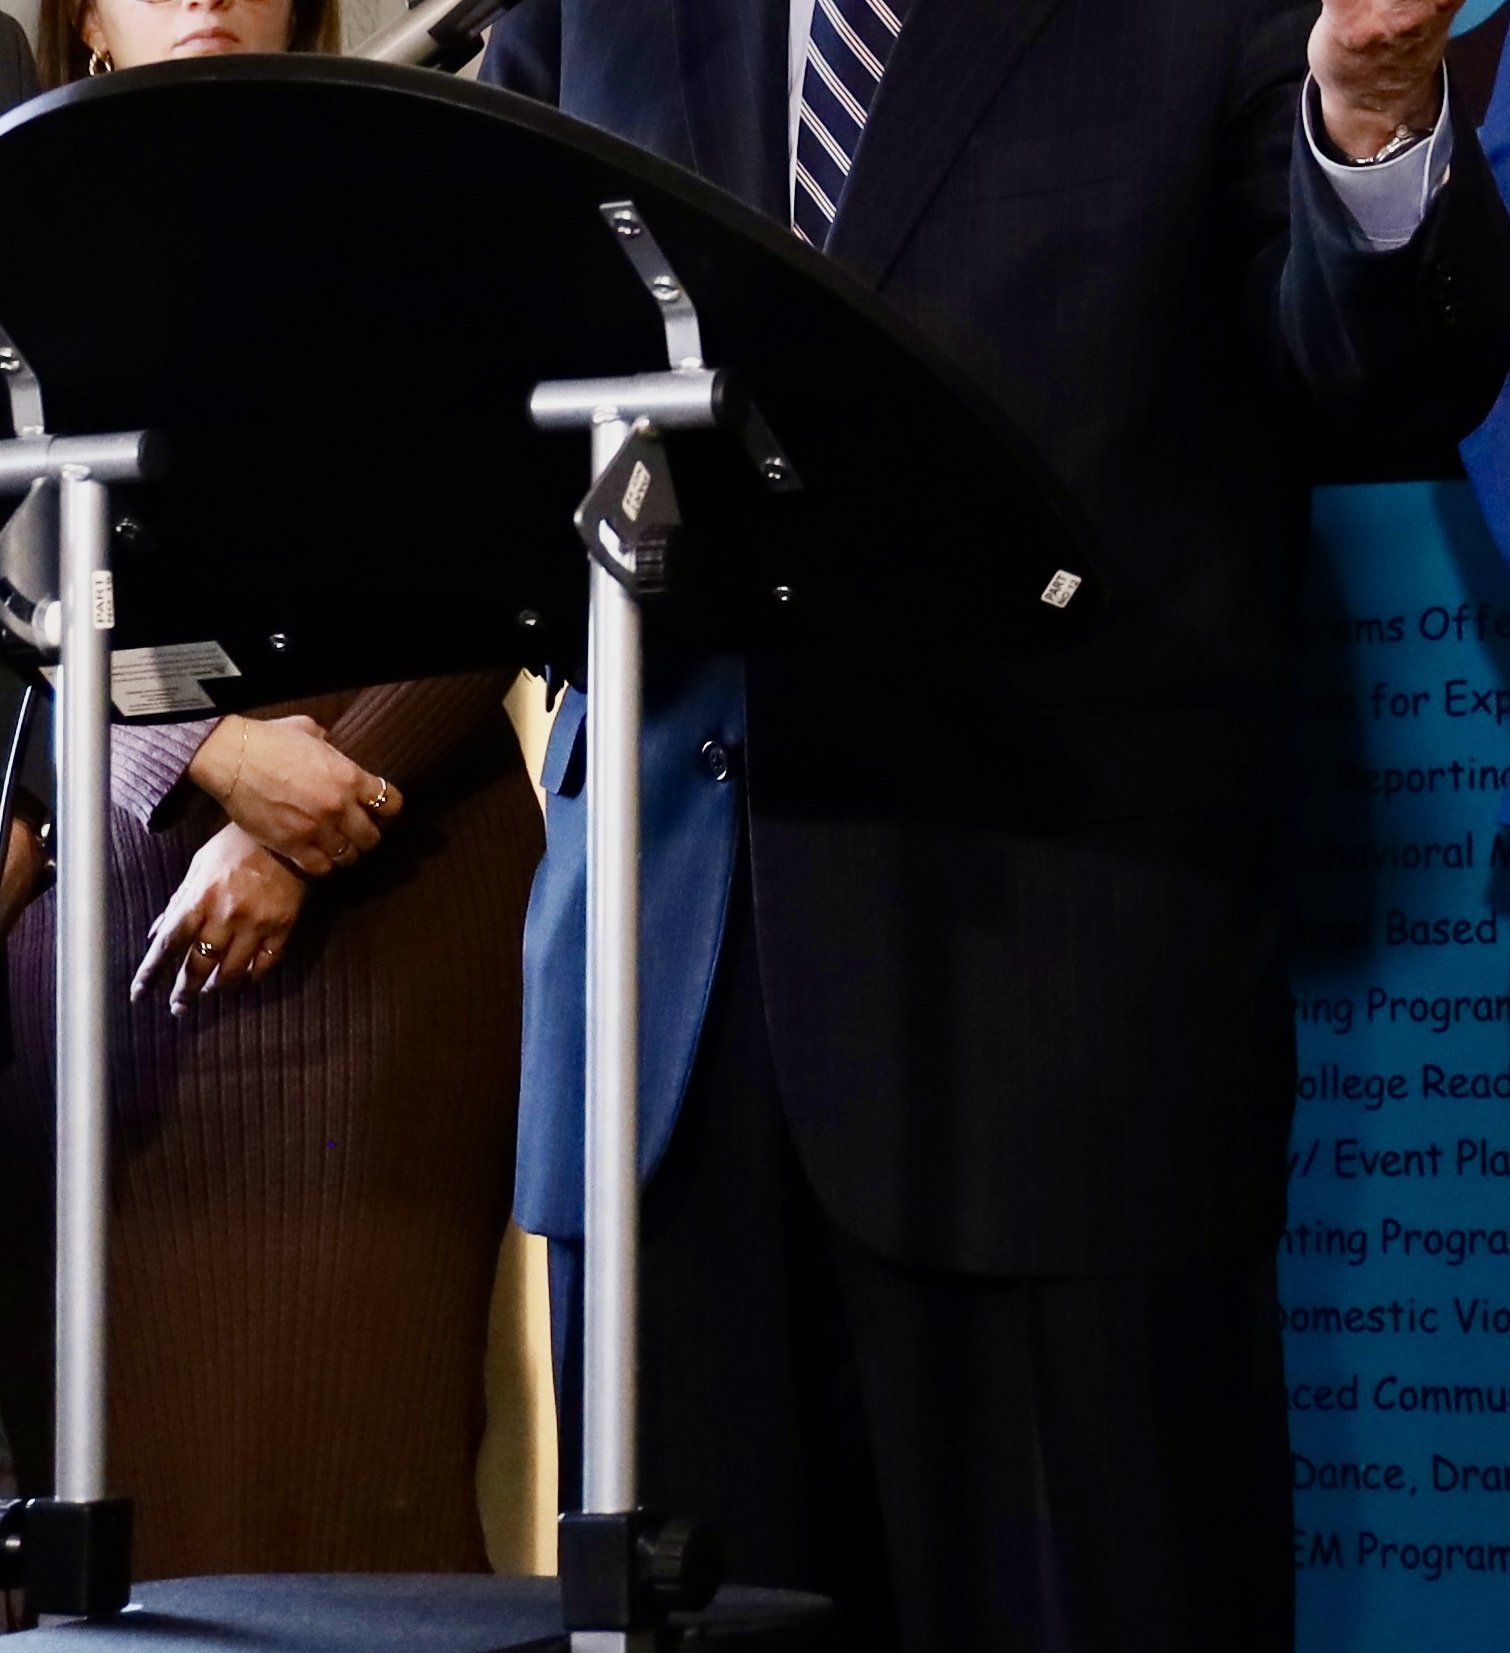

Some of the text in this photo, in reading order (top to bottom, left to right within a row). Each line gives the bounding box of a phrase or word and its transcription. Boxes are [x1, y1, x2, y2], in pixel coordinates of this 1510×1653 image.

[1044, 574, 1067, 601] PART
[1370, 682, 1430, 720] for
[1387, 910, 1497, 947] Based
[1296, 1063, 1409, 1112] ollege
[1335, 1137, 1443, 1180] Event
[1287, 1374, 1359, 1411] ced
